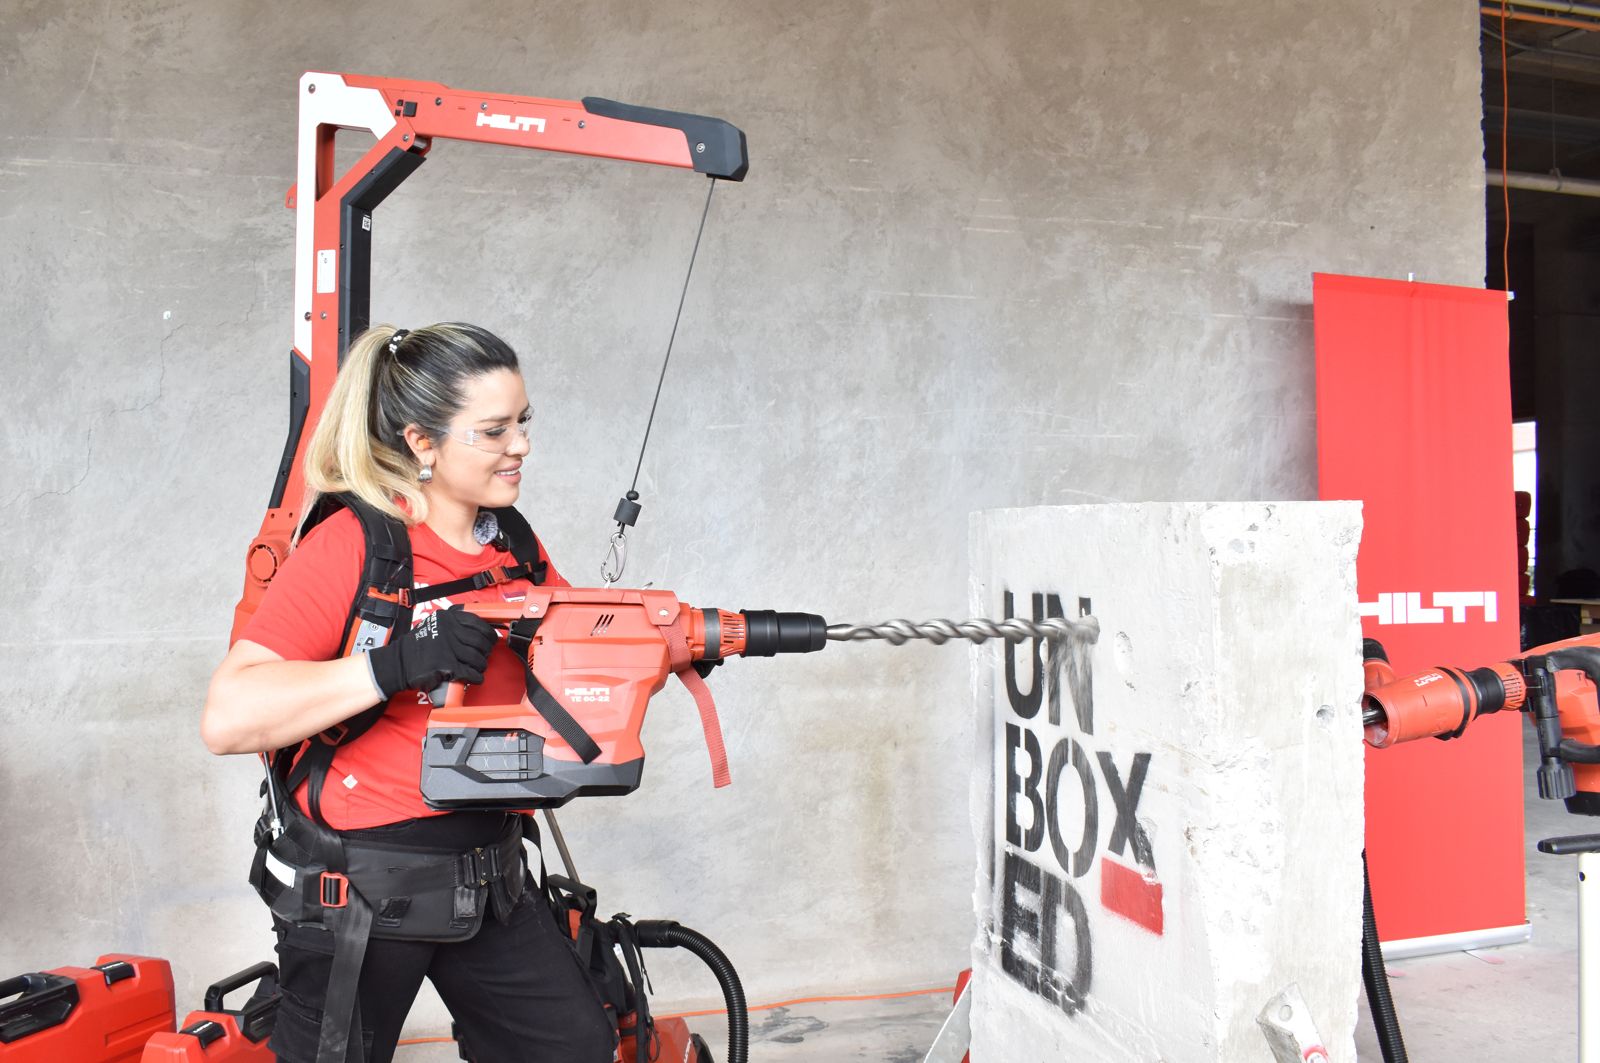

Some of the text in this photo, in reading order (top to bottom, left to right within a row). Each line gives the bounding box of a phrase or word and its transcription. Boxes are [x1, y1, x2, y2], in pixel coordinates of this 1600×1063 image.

[476, 112, 546, 133] HILTI
[564, 687, 610, 696] HILTI
[1004, 590, 1094, 736] UN
[1005, 721, 1158, 879] BOX
[1001, 850, 1092, 1018] ED
